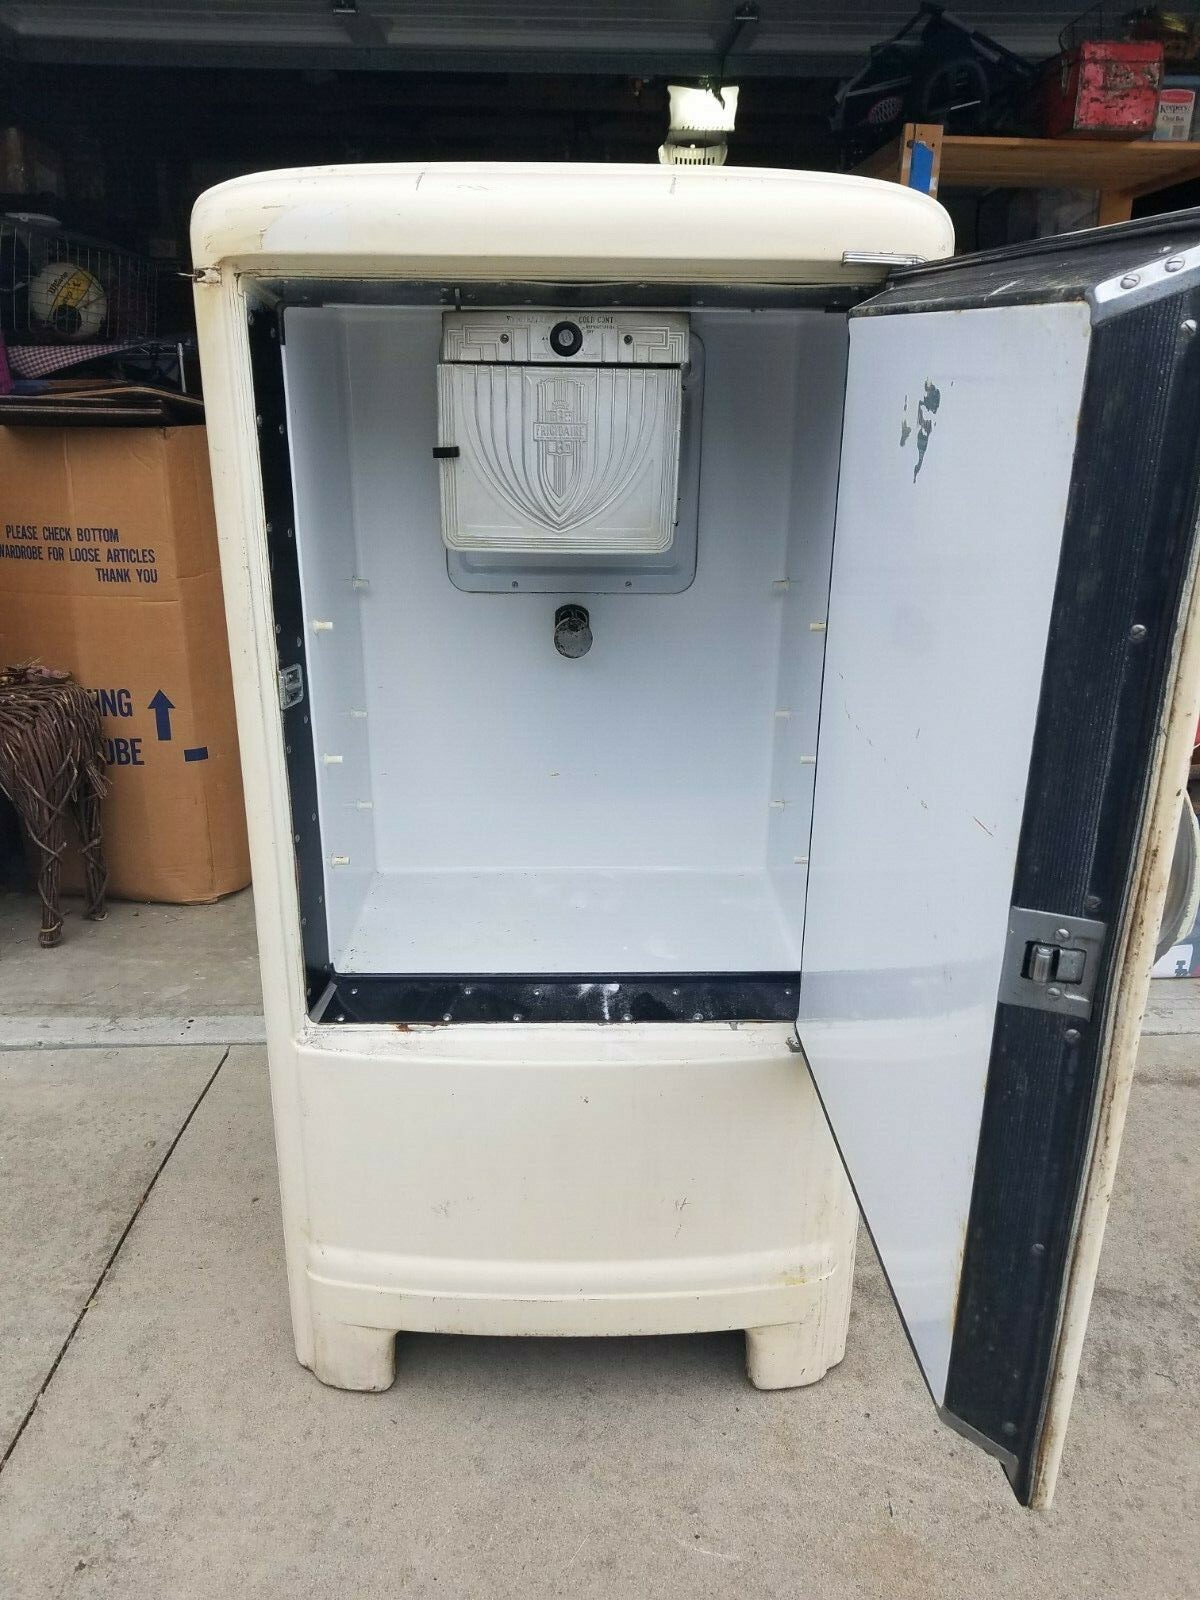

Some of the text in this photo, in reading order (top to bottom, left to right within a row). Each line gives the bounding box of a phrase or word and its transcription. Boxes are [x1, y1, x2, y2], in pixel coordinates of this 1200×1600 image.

[6, 525, 119, 543] PLEASE CHECK BOTTOM
[48, 547, 64, 560] FOR
[69, 548, 100, 562] LOOSE
[106, 549, 155, 563] ARTICLES
[95, 568, 158, 583] THANK YOU
